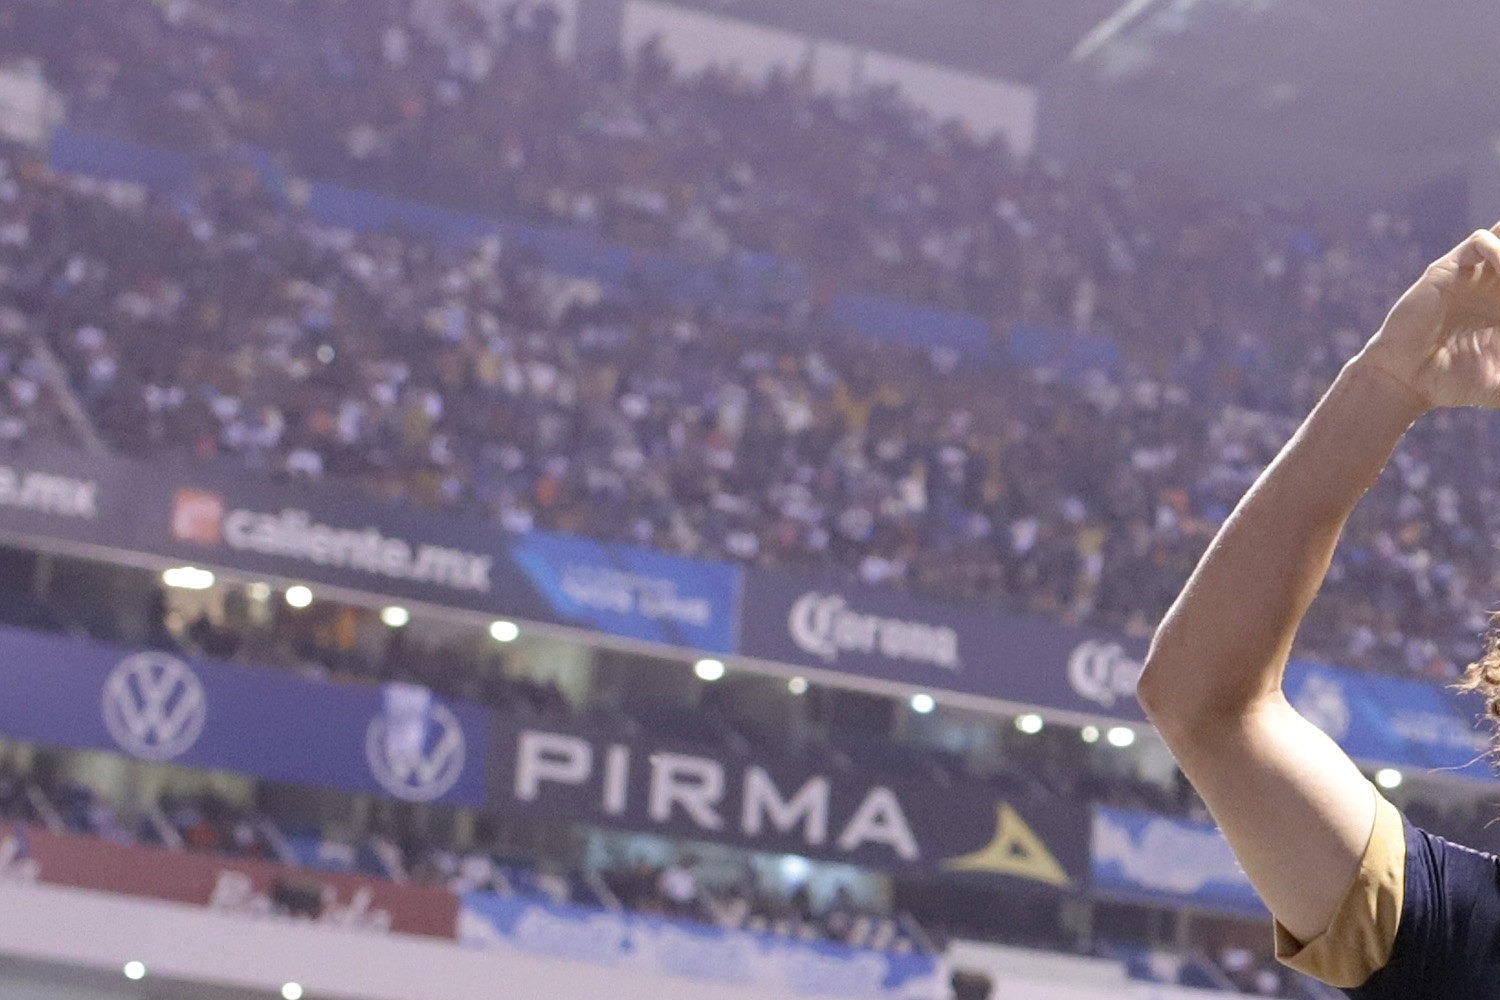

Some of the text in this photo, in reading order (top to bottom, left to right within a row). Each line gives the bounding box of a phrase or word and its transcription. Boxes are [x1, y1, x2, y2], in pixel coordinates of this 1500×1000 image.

[224, 508, 492, 593] caliente.mx
[789, 592, 963, 670] Corona
[514, 730, 919, 861] PIRMA
